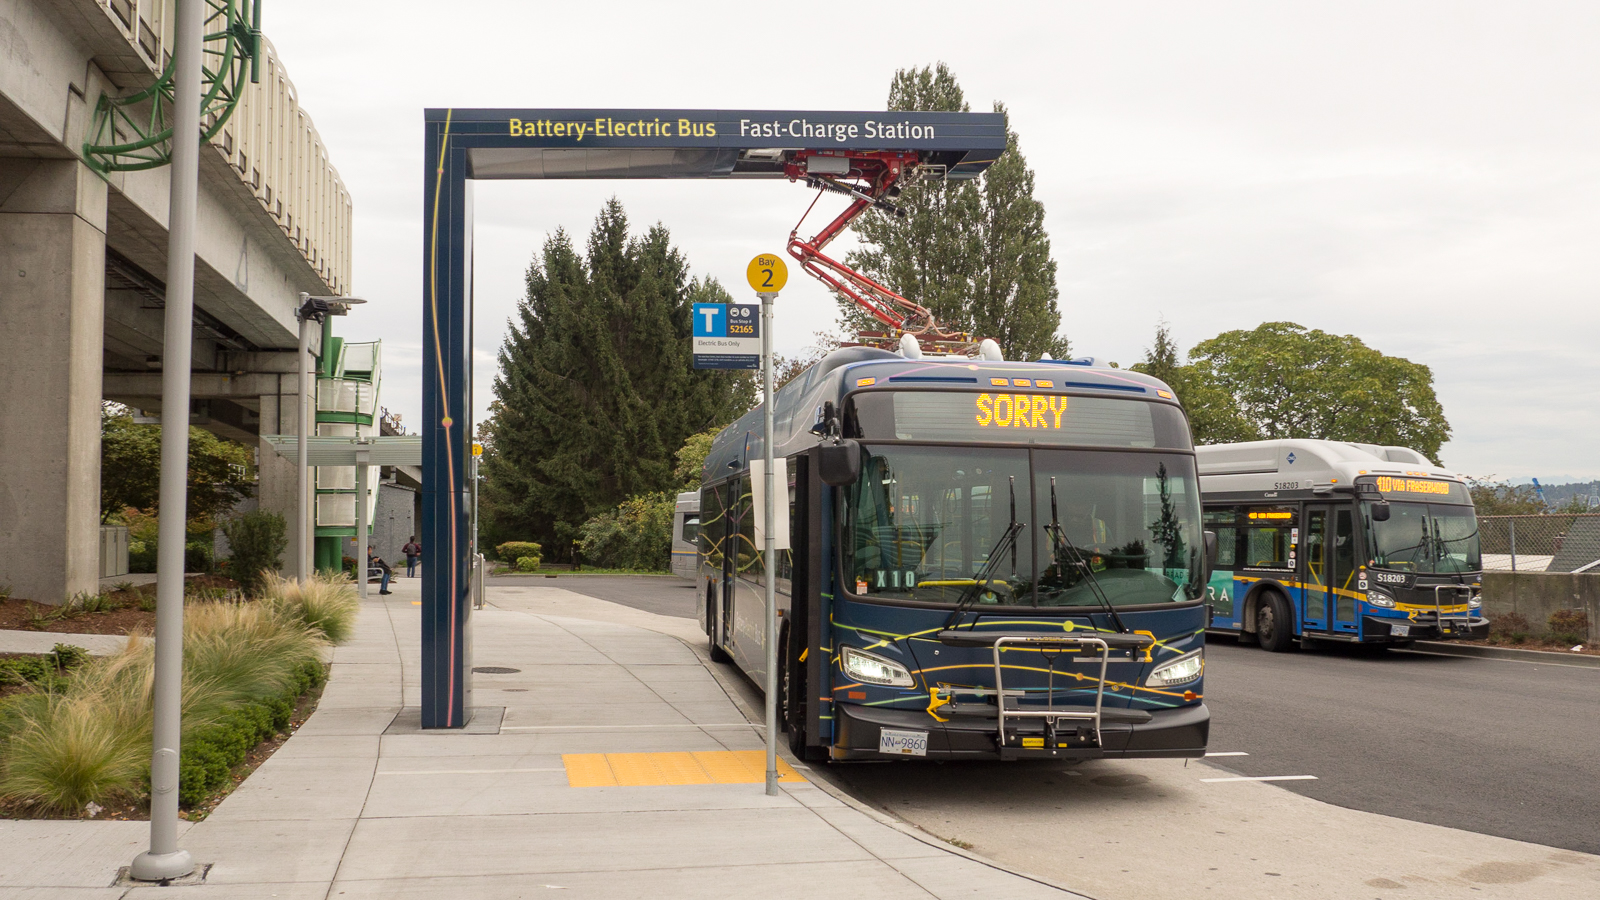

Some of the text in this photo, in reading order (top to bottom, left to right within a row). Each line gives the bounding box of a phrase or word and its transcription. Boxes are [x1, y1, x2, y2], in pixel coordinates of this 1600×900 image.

[509, 117, 935, 142] Battery-Electric Bus Fast-Charge Station
[758, 257, 776, 268] Bay
[761, 268, 774, 288] 2
[699, 307, 720, 333] T
[730, 325, 754, 334] 52165
[976, 392, 1068, 429] SORRY
[1274, 481, 1299, 490] S18203
[1376, 475, 1450, 495] 410 VIA FRASERWOOD
[1377, 573, 1406, 584] S18203
[881, 736, 927, 751] NN 9860
